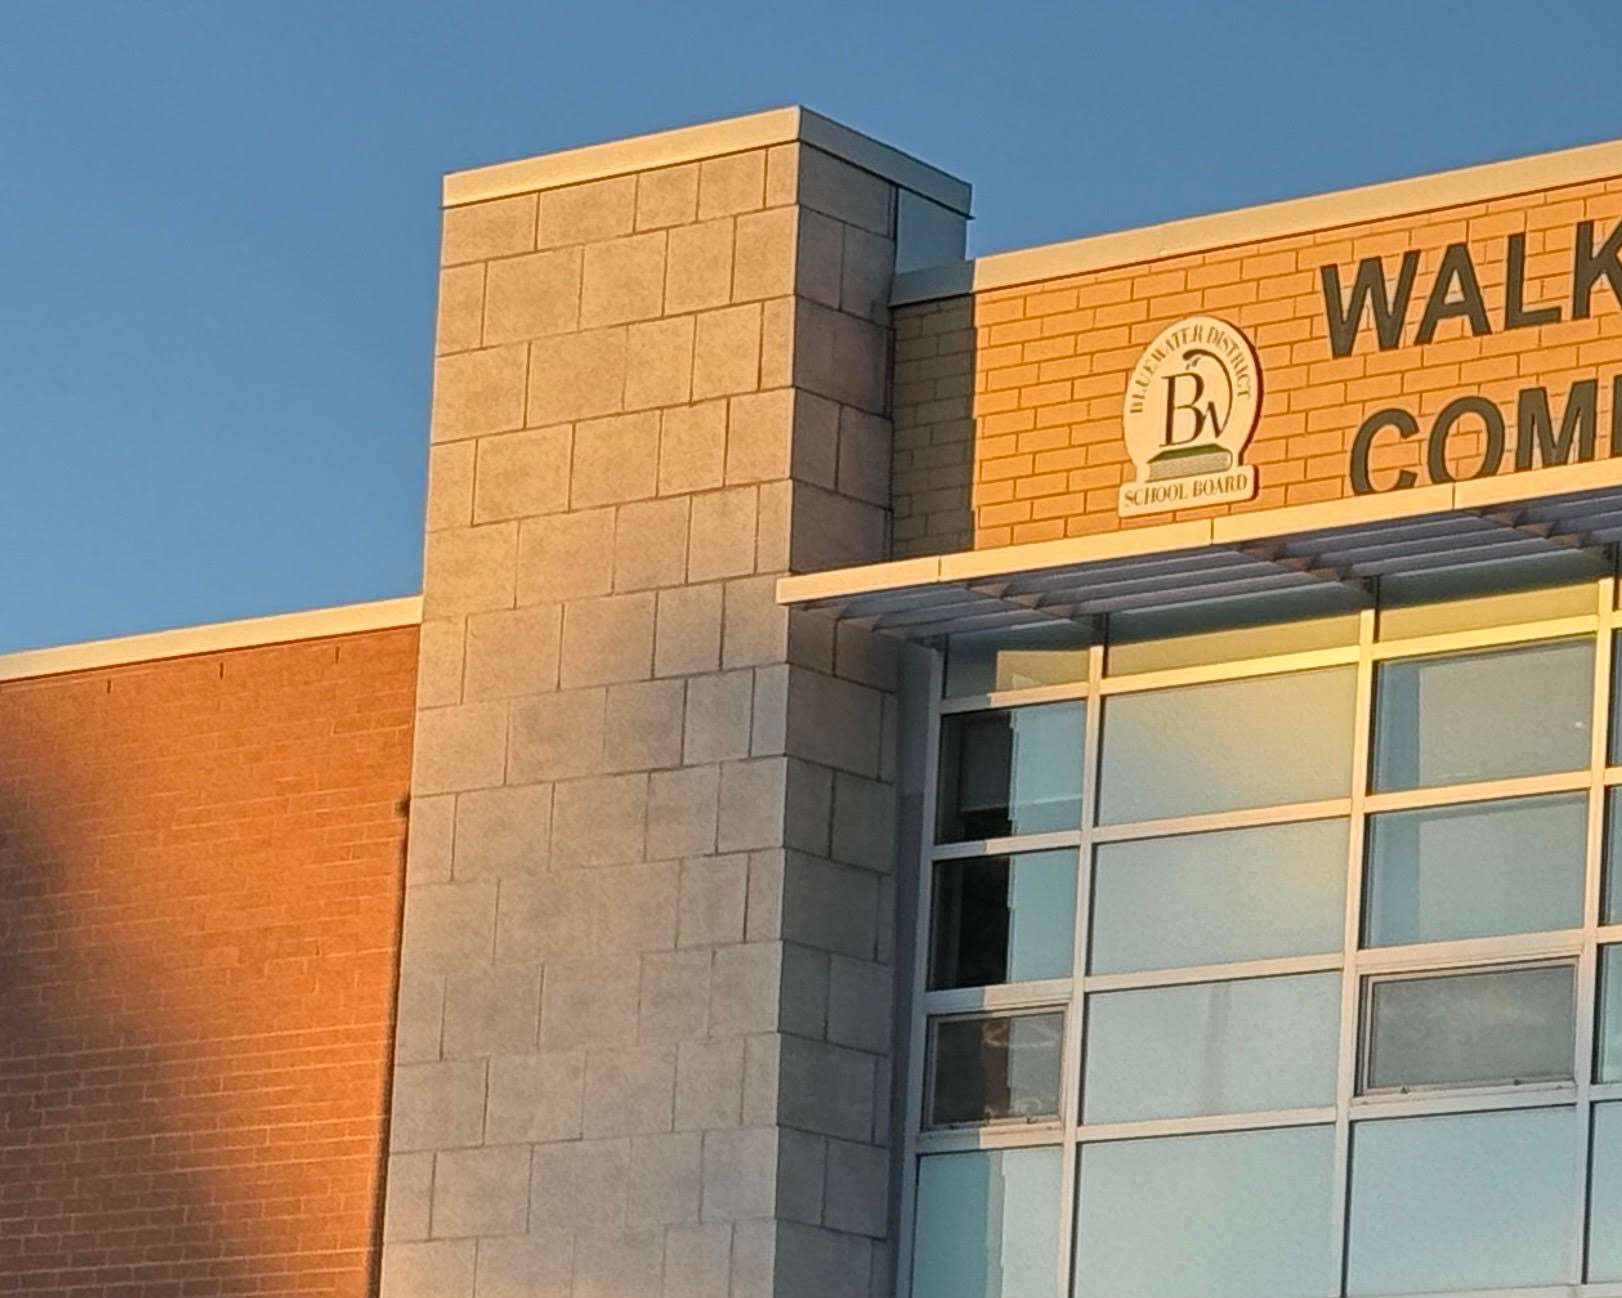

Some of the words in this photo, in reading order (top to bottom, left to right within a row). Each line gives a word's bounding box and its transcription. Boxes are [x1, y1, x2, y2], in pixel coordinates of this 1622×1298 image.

[1129, 324, 1204, 414] BLUEWATER
[1206, 326, 1252, 400] DISTRICT
[1124, 484, 1188, 508] SCHOOL
[1192, 474, 1248, 498] BOARD
